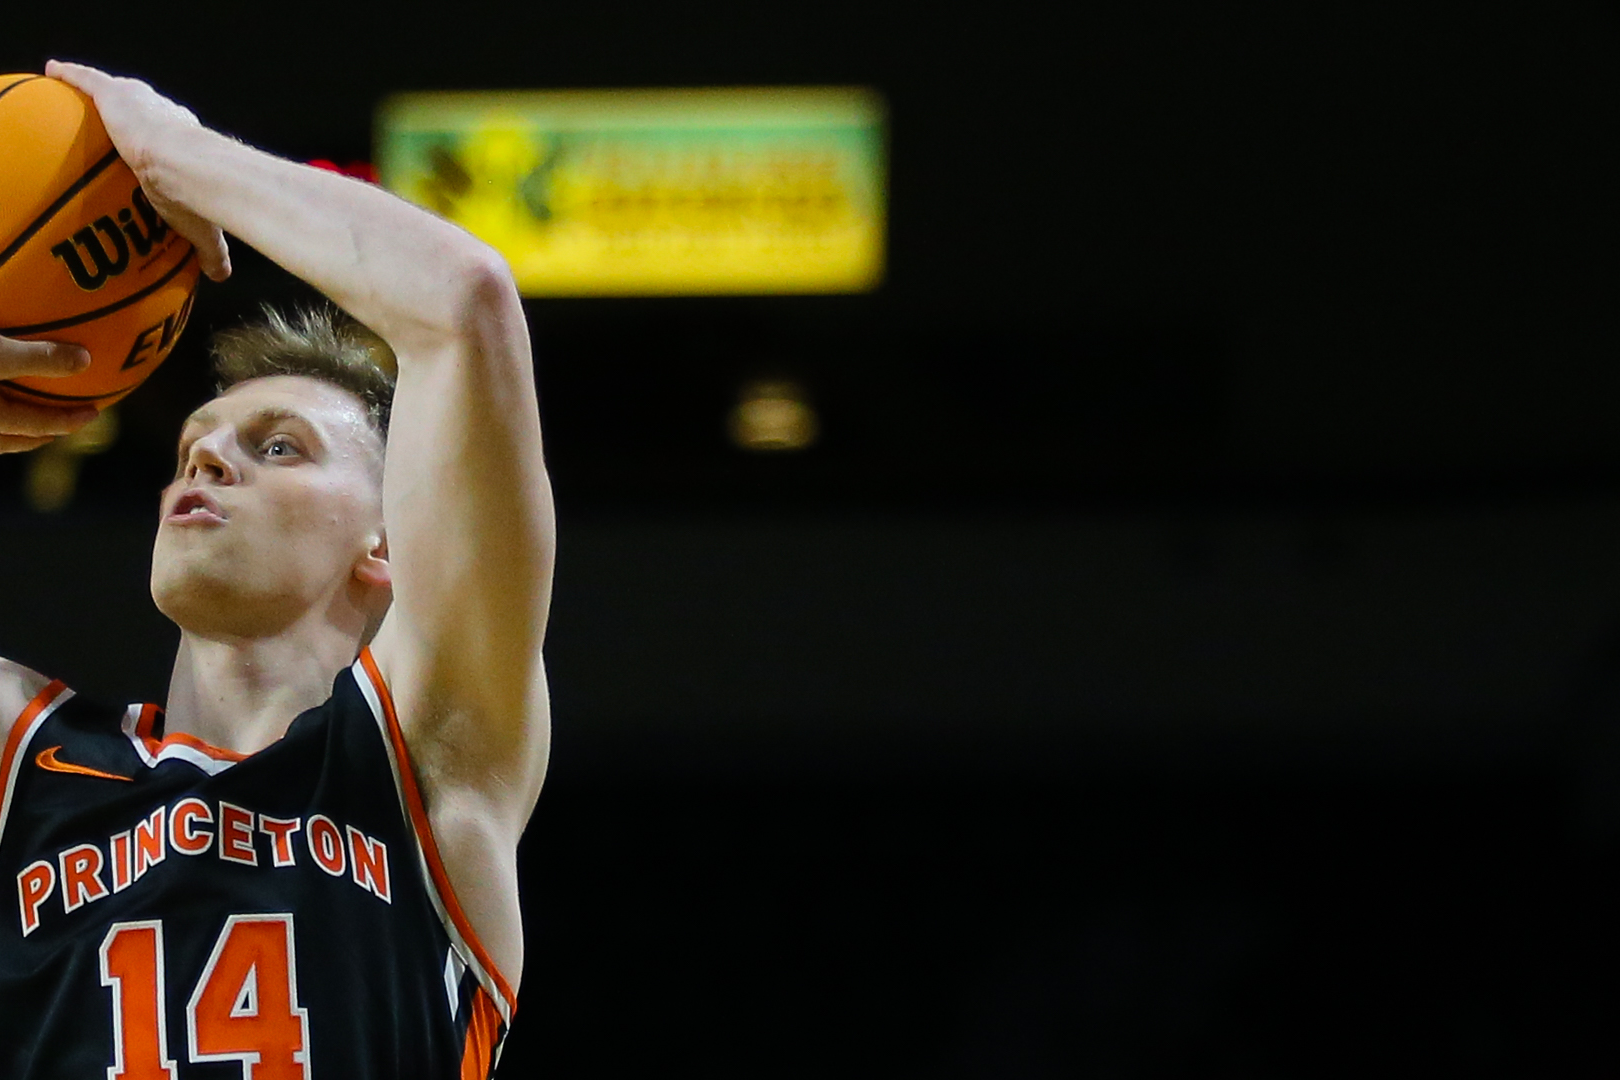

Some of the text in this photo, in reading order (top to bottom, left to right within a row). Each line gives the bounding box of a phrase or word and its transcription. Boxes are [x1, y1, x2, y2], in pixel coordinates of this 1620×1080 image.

[50, 186, 168, 291] Wil
[120, 293, 193, 371] EV
[17, 798, 391, 937] PRINCETON
